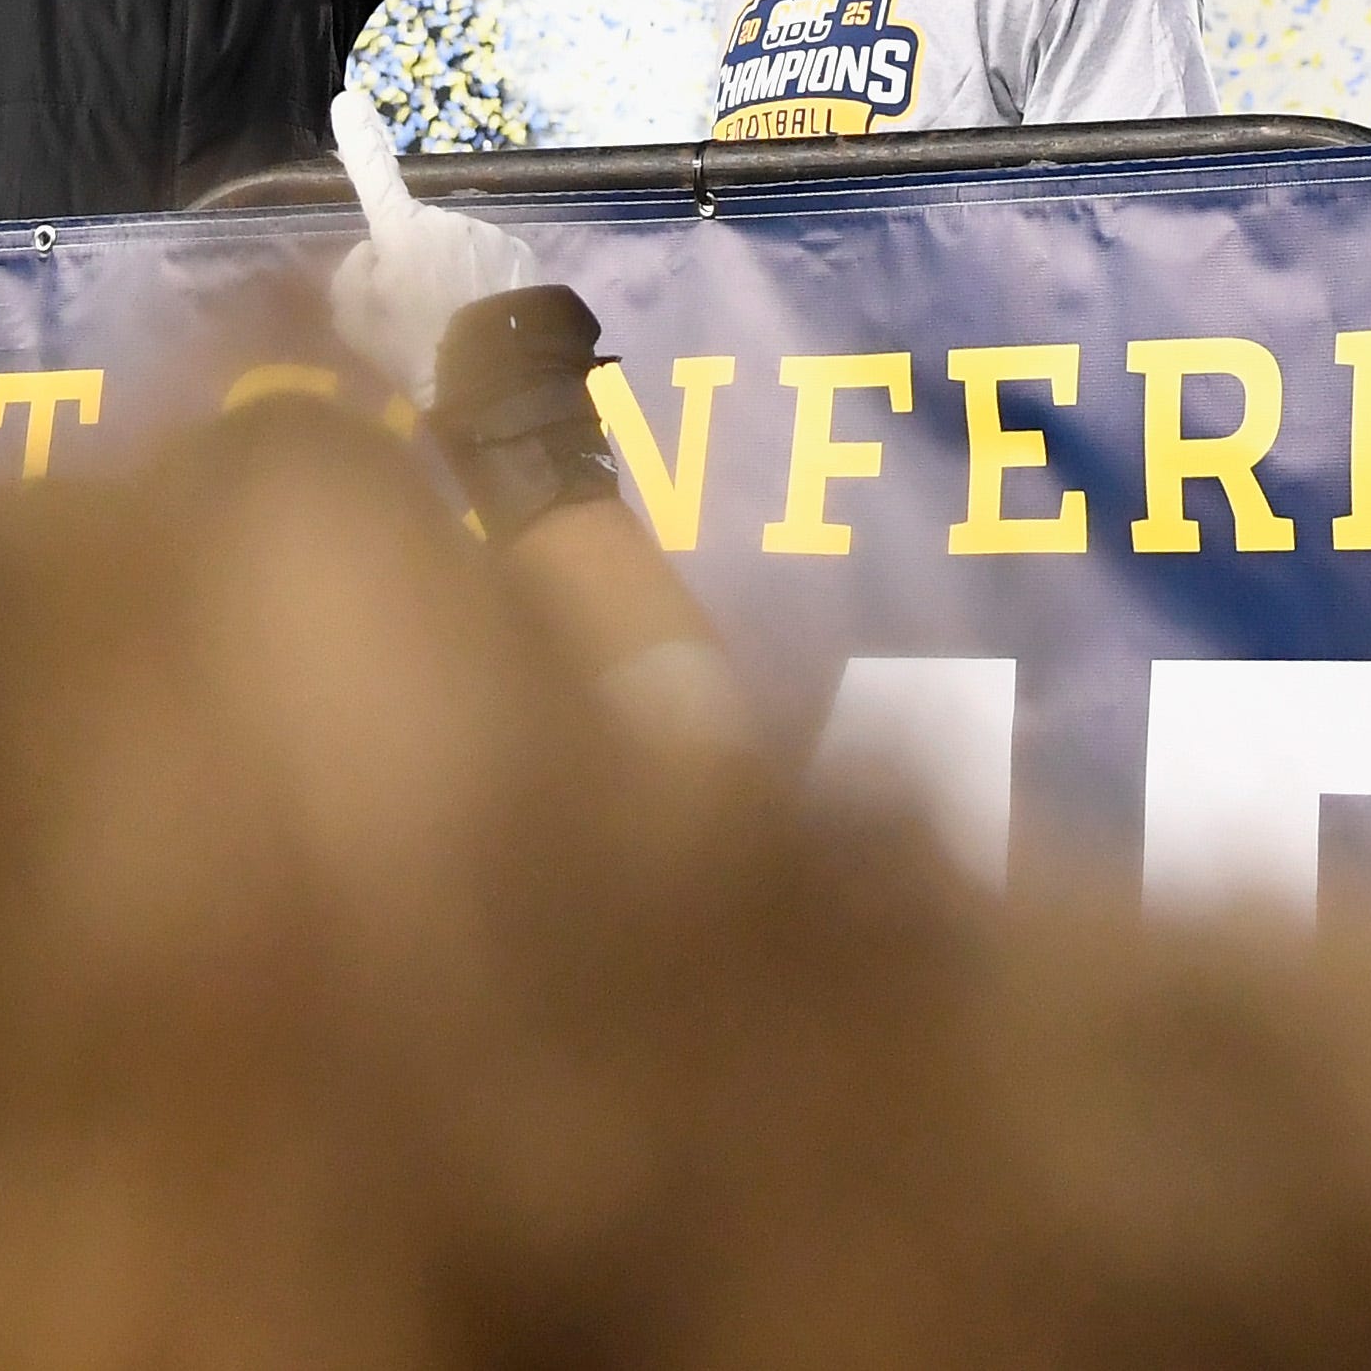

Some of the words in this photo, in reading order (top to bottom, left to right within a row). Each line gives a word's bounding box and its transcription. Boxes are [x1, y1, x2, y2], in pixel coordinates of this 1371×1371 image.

[737, 17, 762, 46] 20
[841, 0, 874, 26] 25
[714, 39, 911, 113] CHAMPIONS
[725, 107, 838, 141] FOOTBALL
